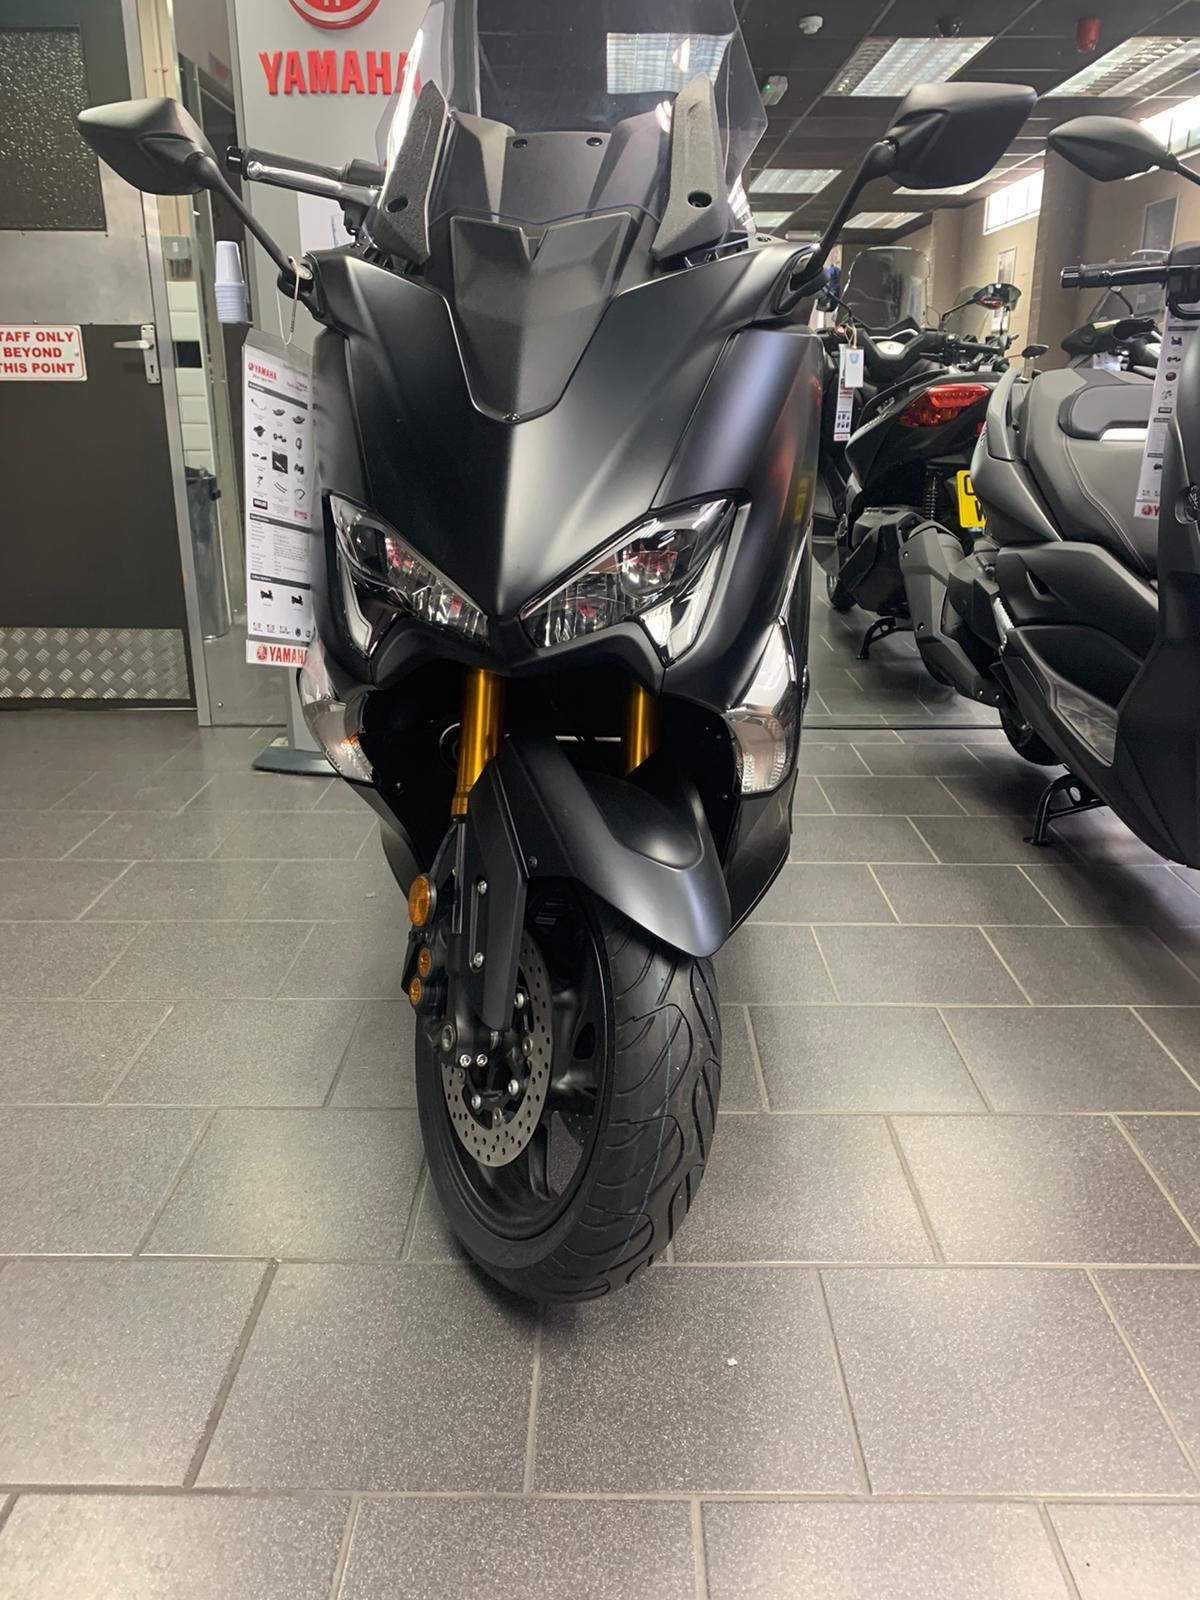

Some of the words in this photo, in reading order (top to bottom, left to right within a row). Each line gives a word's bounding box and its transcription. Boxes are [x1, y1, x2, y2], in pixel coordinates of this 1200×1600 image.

[259, 49, 422, 97] YAMAHA
[35, 331, 74, 342] ONLY
[3, 347, 62, 358] BEYOND
[0, 363, 28, 373] HIS
[32, 363, 75, 373] POINT
